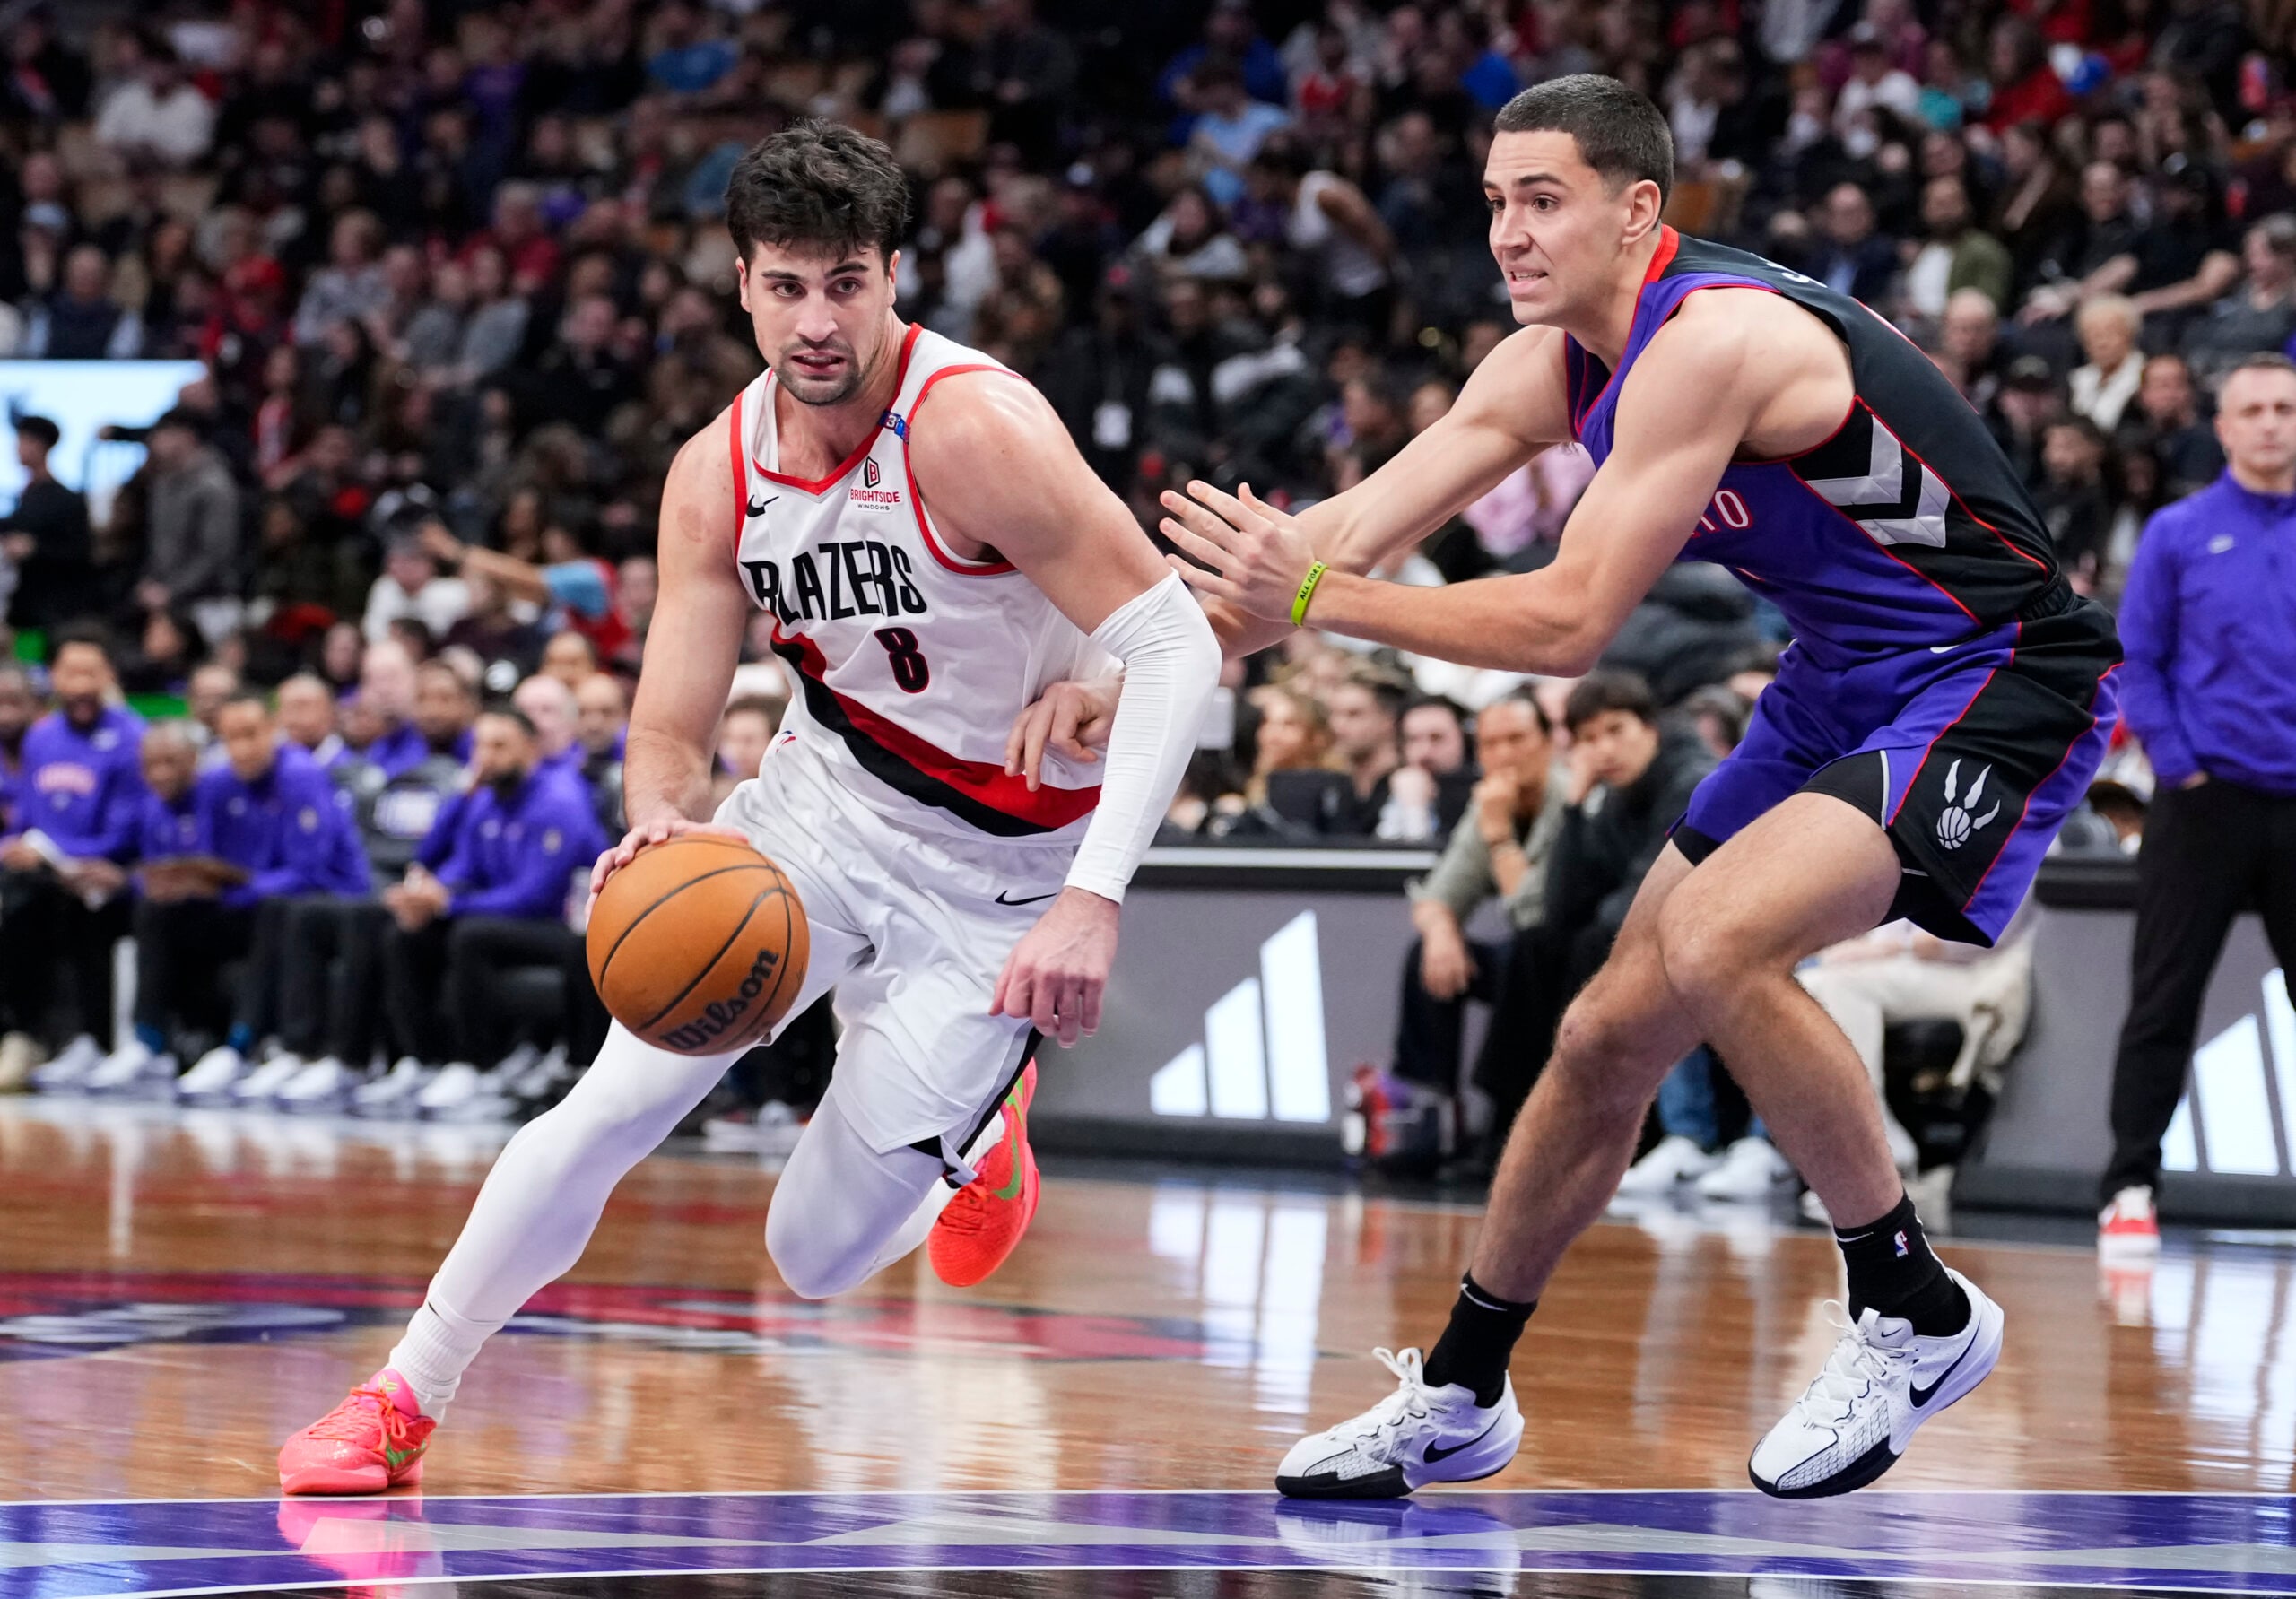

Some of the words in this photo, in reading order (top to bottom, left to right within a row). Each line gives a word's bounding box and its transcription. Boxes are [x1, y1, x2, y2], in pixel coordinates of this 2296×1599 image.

[869, 463, 878, 482] B
[850, 488, 901, 504] BRIGHTSIDE
[739, 540, 928, 627] BLAZERS
[1300, 585, 1310, 600] ALL
[874, 626, 931, 694] 8
[659, 949, 779, 1049] Wilson
